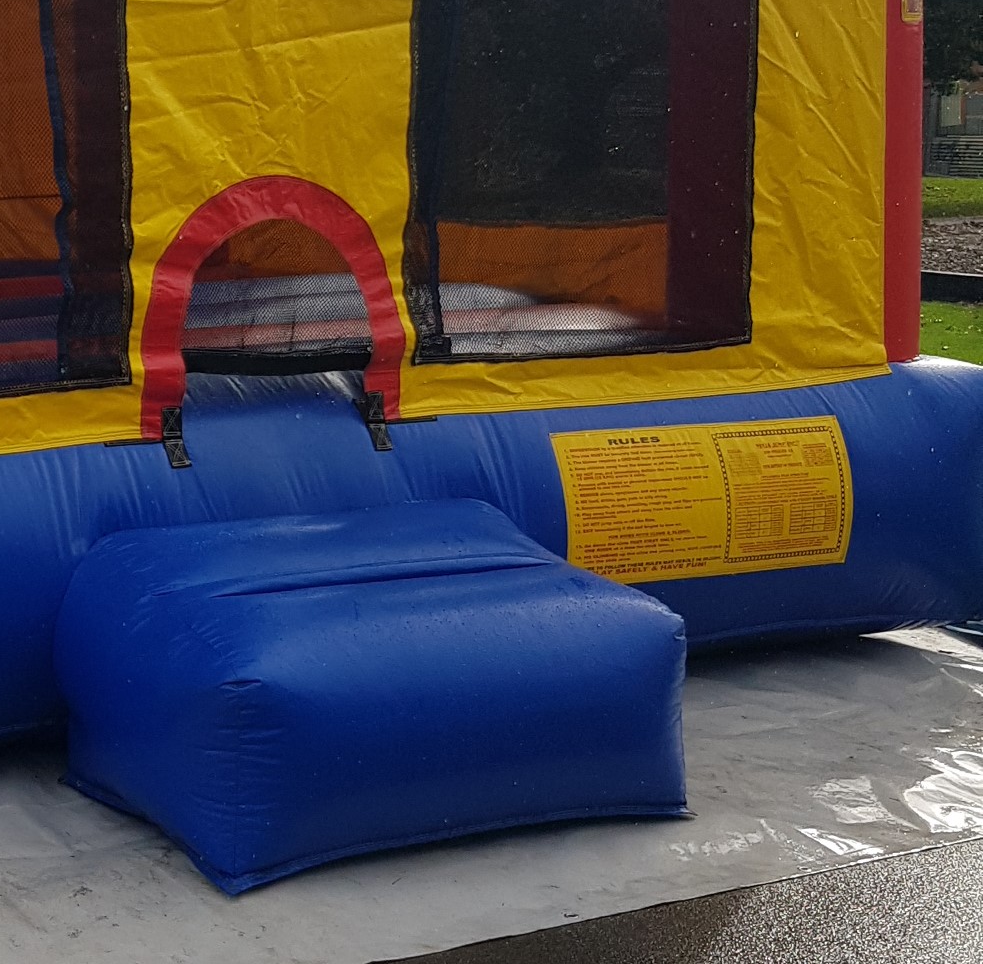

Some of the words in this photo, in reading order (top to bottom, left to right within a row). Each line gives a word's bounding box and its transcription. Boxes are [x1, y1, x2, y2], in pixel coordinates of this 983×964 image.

[607, 436, 661, 446] RULES
[615, 566, 648, 574] SAFELY
[660, 563, 684, 571] HAVE
